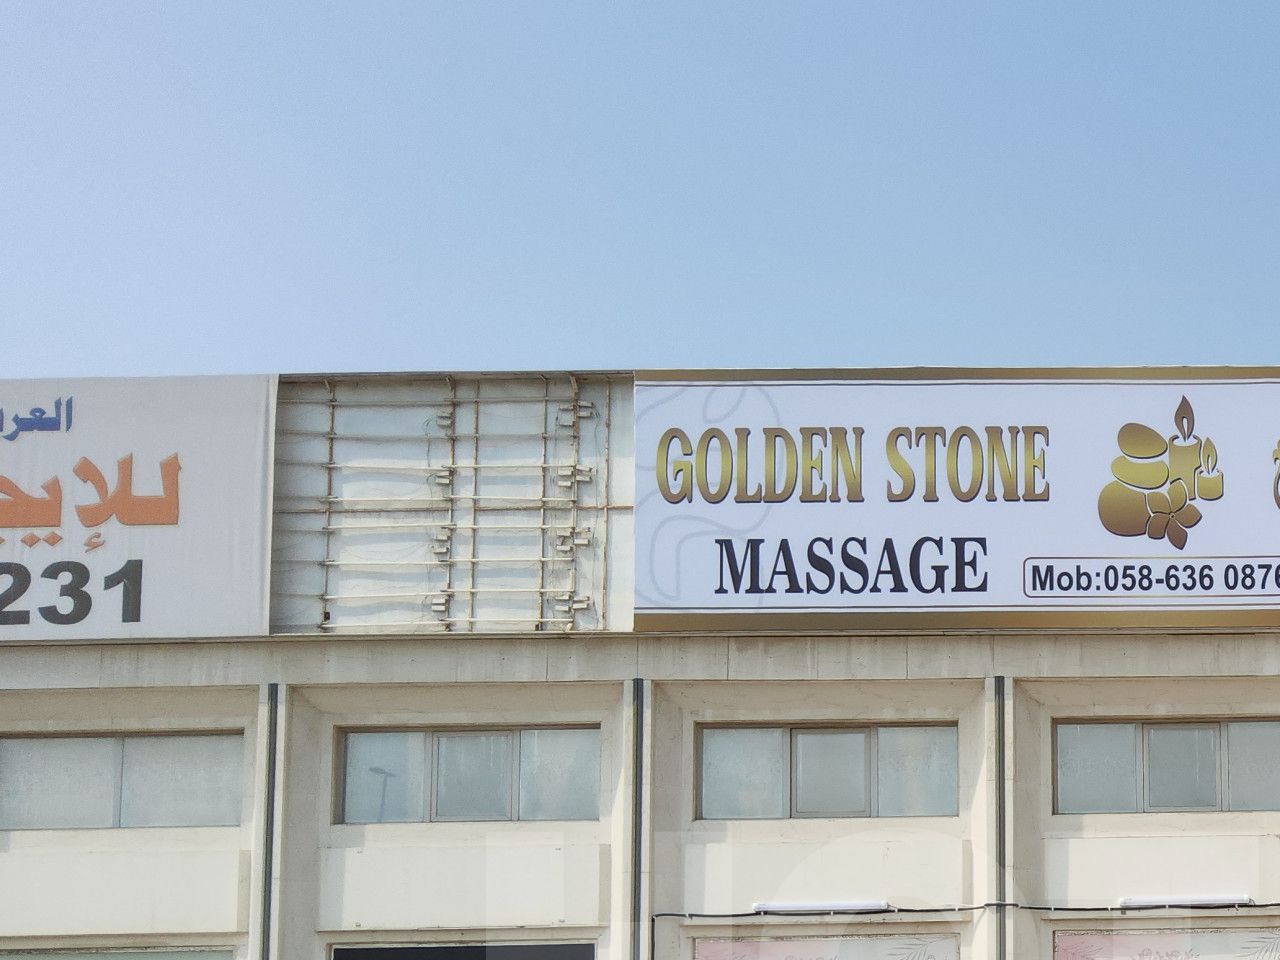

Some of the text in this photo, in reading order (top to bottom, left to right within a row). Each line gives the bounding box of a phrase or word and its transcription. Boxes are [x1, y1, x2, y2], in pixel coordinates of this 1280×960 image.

[655, 425, 1051, 504] GOLDEN STONE
[0, 559, 143, 625] 231
[714, 535, 988, 595] MASSAGE
[1030, 563, 1214, 593] Mob:058-636
